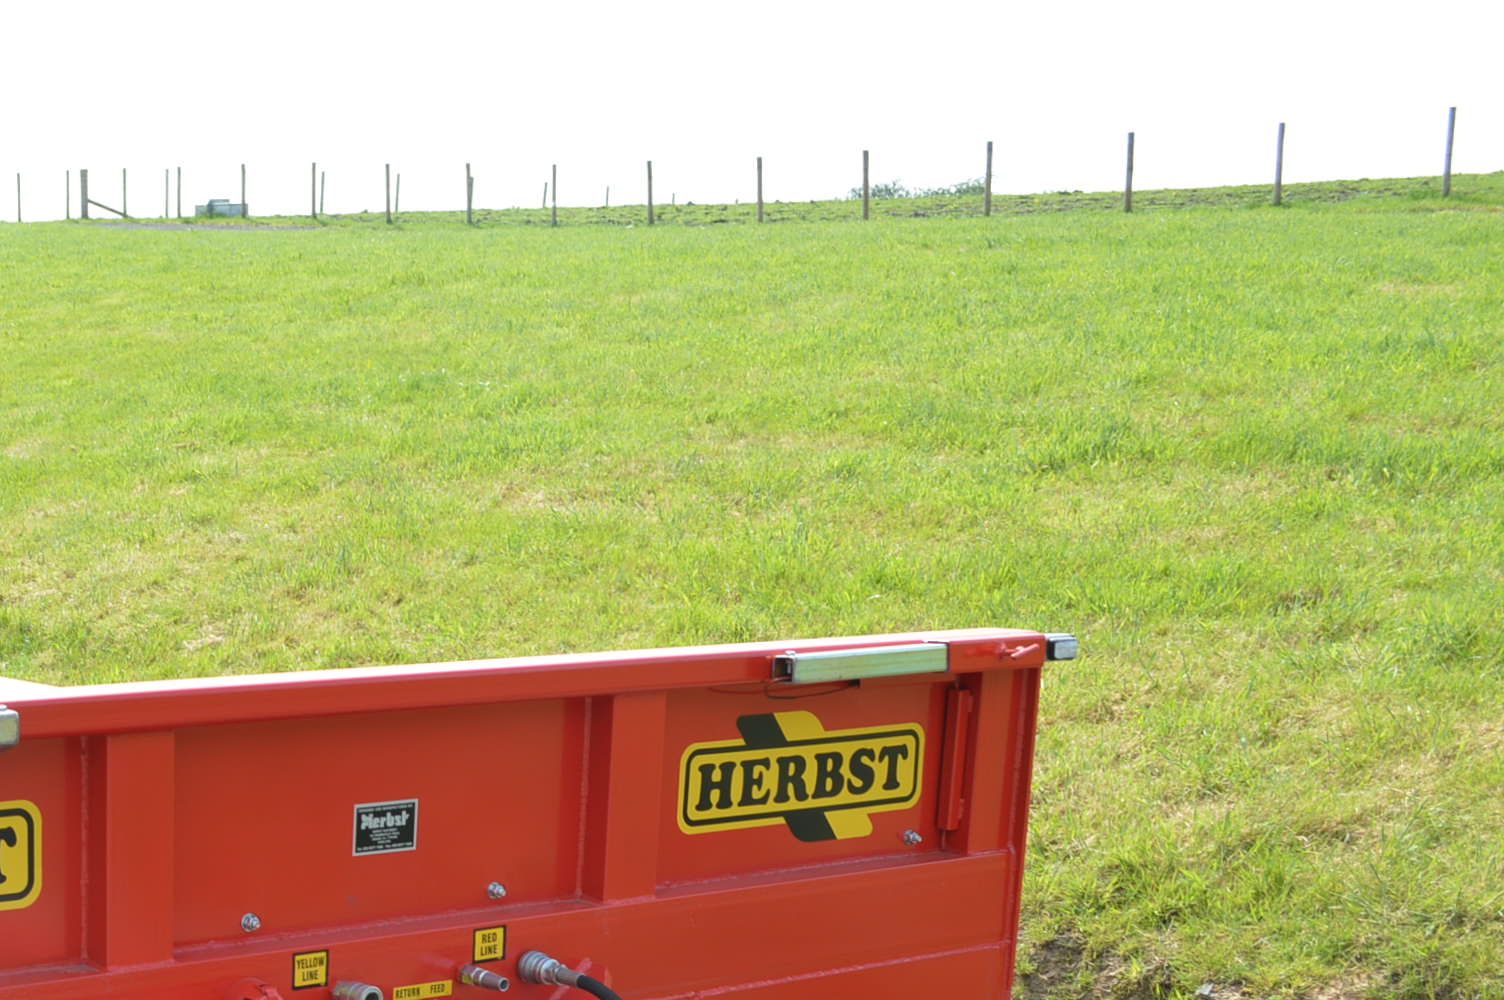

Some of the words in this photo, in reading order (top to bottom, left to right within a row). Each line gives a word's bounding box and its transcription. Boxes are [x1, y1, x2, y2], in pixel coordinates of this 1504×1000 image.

[694, 743, 909, 812] HERBST
[481, 932, 498, 943] RED
[479, 944, 498, 957] LINE
[296, 955, 325, 970] YELLOW
[301, 969, 319, 982] LINE
[395, 986, 421, 999] RETURN
[429, 983, 445, 994] FEED
